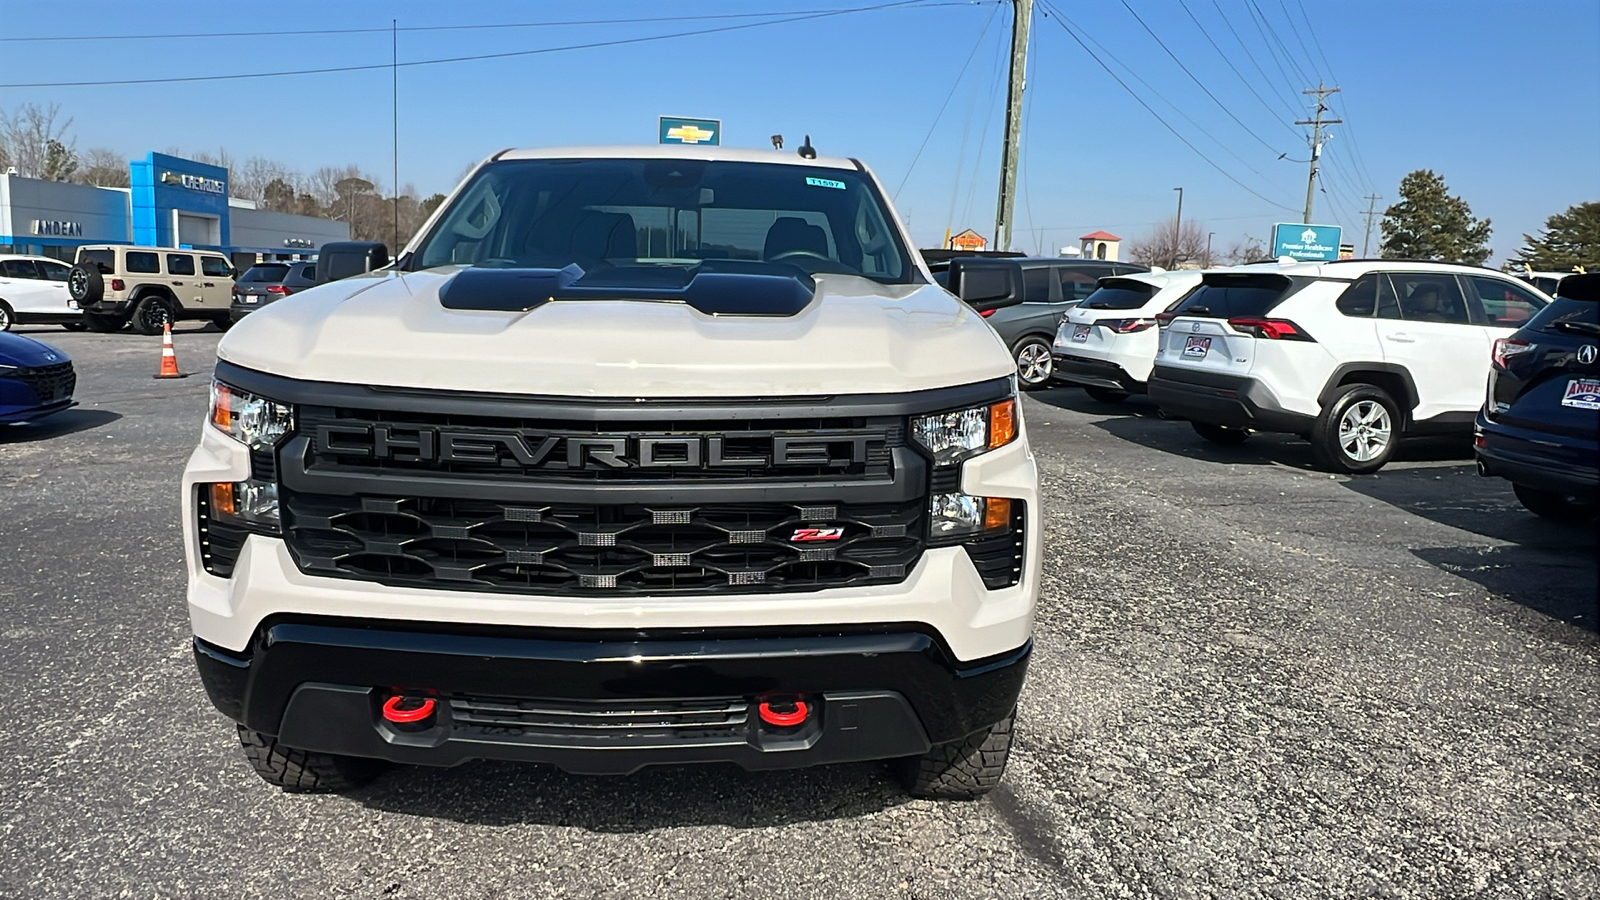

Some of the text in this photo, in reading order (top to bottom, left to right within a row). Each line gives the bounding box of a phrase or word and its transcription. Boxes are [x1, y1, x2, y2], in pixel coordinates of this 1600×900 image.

[181, 174, 225, 194] CHEVROLET
[36, 219, 82, 236] ANDEAN
[1282, 242, 1333, 252] Premier Healthcare
[1289, 250, 1325, 258] Professionals
[316, 423, 886, 468] CHEVROLET
